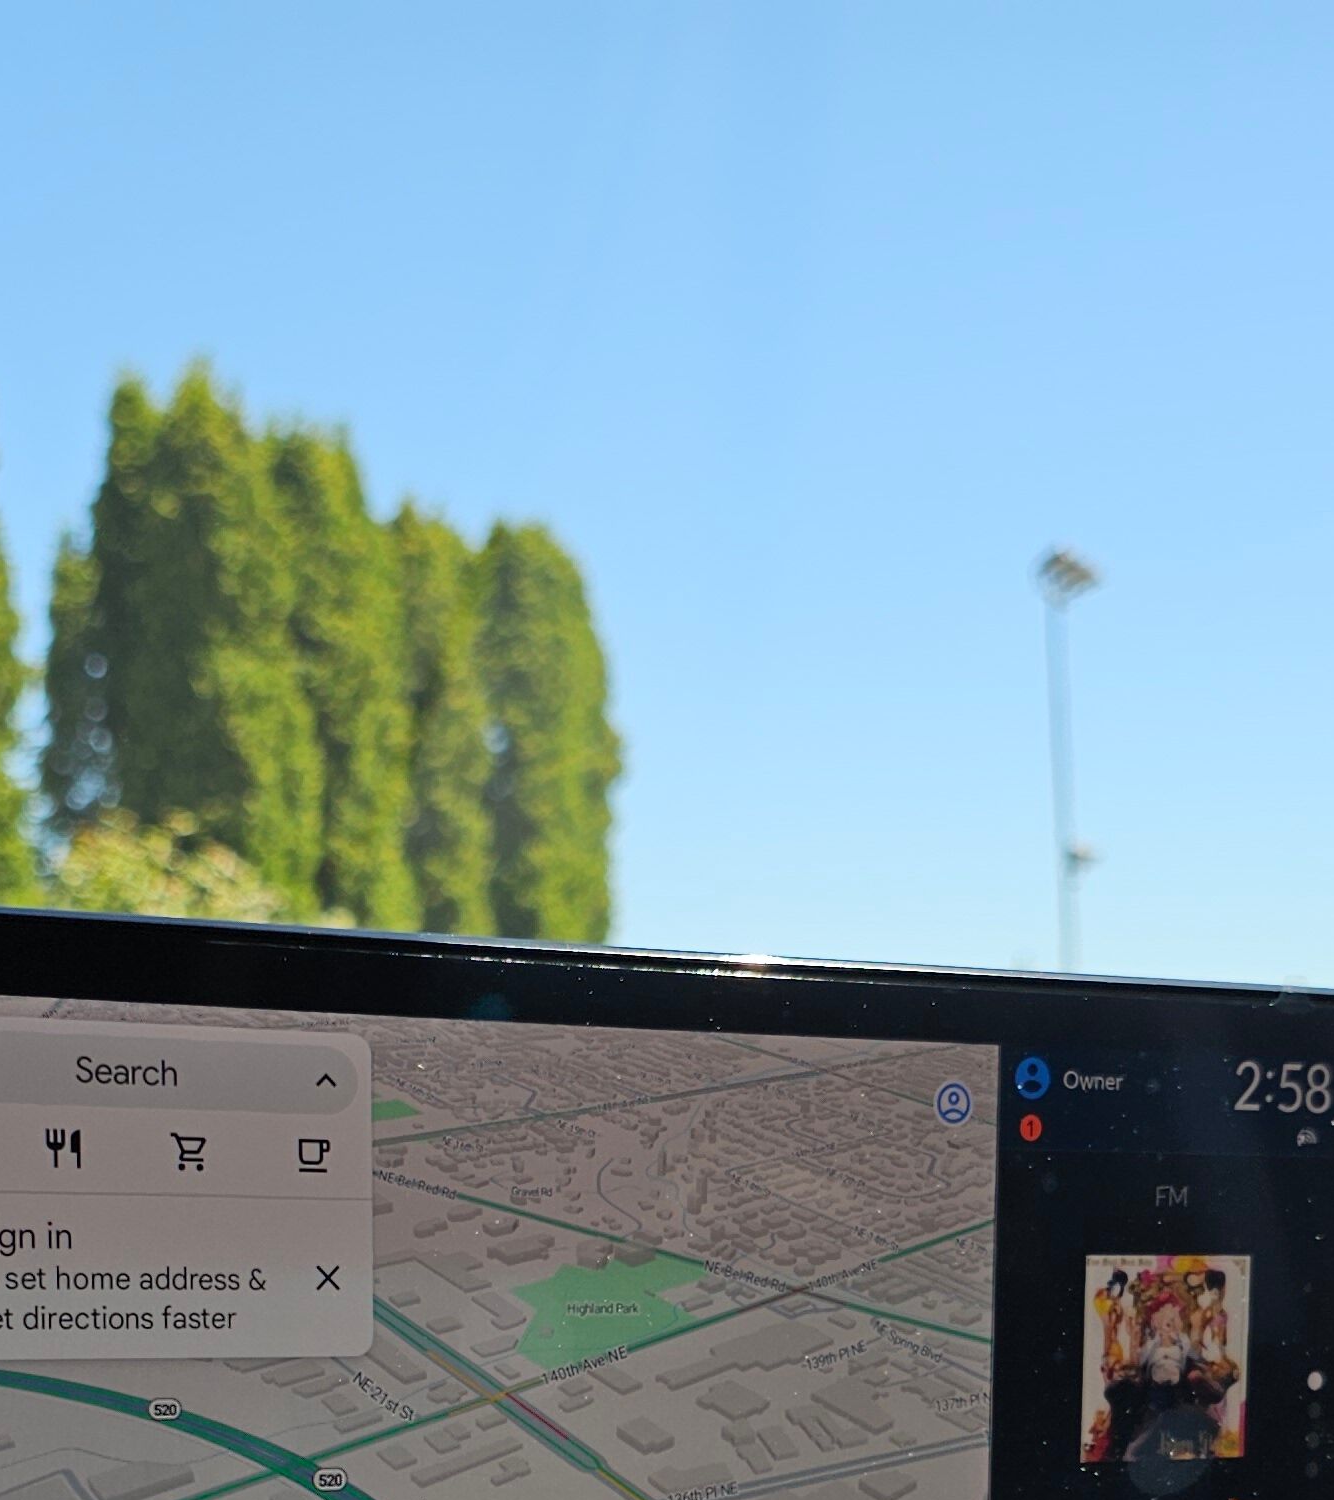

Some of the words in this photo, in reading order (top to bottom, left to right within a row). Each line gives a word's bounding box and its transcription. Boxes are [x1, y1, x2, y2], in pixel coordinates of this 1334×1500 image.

[75, 1054, 180, 1088] Search
[1063, 1070, 1124, 1093] Owner
[1233, 1061, 1332, 1114] 2:58
[378, 1170, 395, 1185] NE
[1154, 1185, 1188, 1208] FM
[47, 1223, 73, 1251] in
[5, 1267, 47, 1291] set
[56, 1266, 132, 1291] home
[139, 1266, 240, 1292] address
[248, 1268, 267, 1292] &
[704, 1259, 722, 1275] NE
[23, 1305, 154, 1331] directions
[162, 1305, 237, 1331] faster
[567, 1302, 614, 1316] Highland
[616, 1302, 639, 1314] Park
[873, 1320, 889, 1337] NE
[888, 1327, 921, 1354] Spring
[920, 1344, 943, 1363] Blvd
[541, 1363, 580, 1384] 140th
[582, 1354, 607, 1373] Ave
[607, 1346, 628, 1362] NE
[805, 1353, 837, 1371] 139th
[850, 1341, 867, 1356] NE
[352, 1371, 372, 1394] NE
[369, 1385, 400, 1411] 21st
[398, 1402, 415, 1421] St
[153, 1403, 178, 1417] 520
[318, 1473, 343, 1487] 520
[705, 1485, 718, 1500] Pl
[720, 1481, 739, 1497] NE
